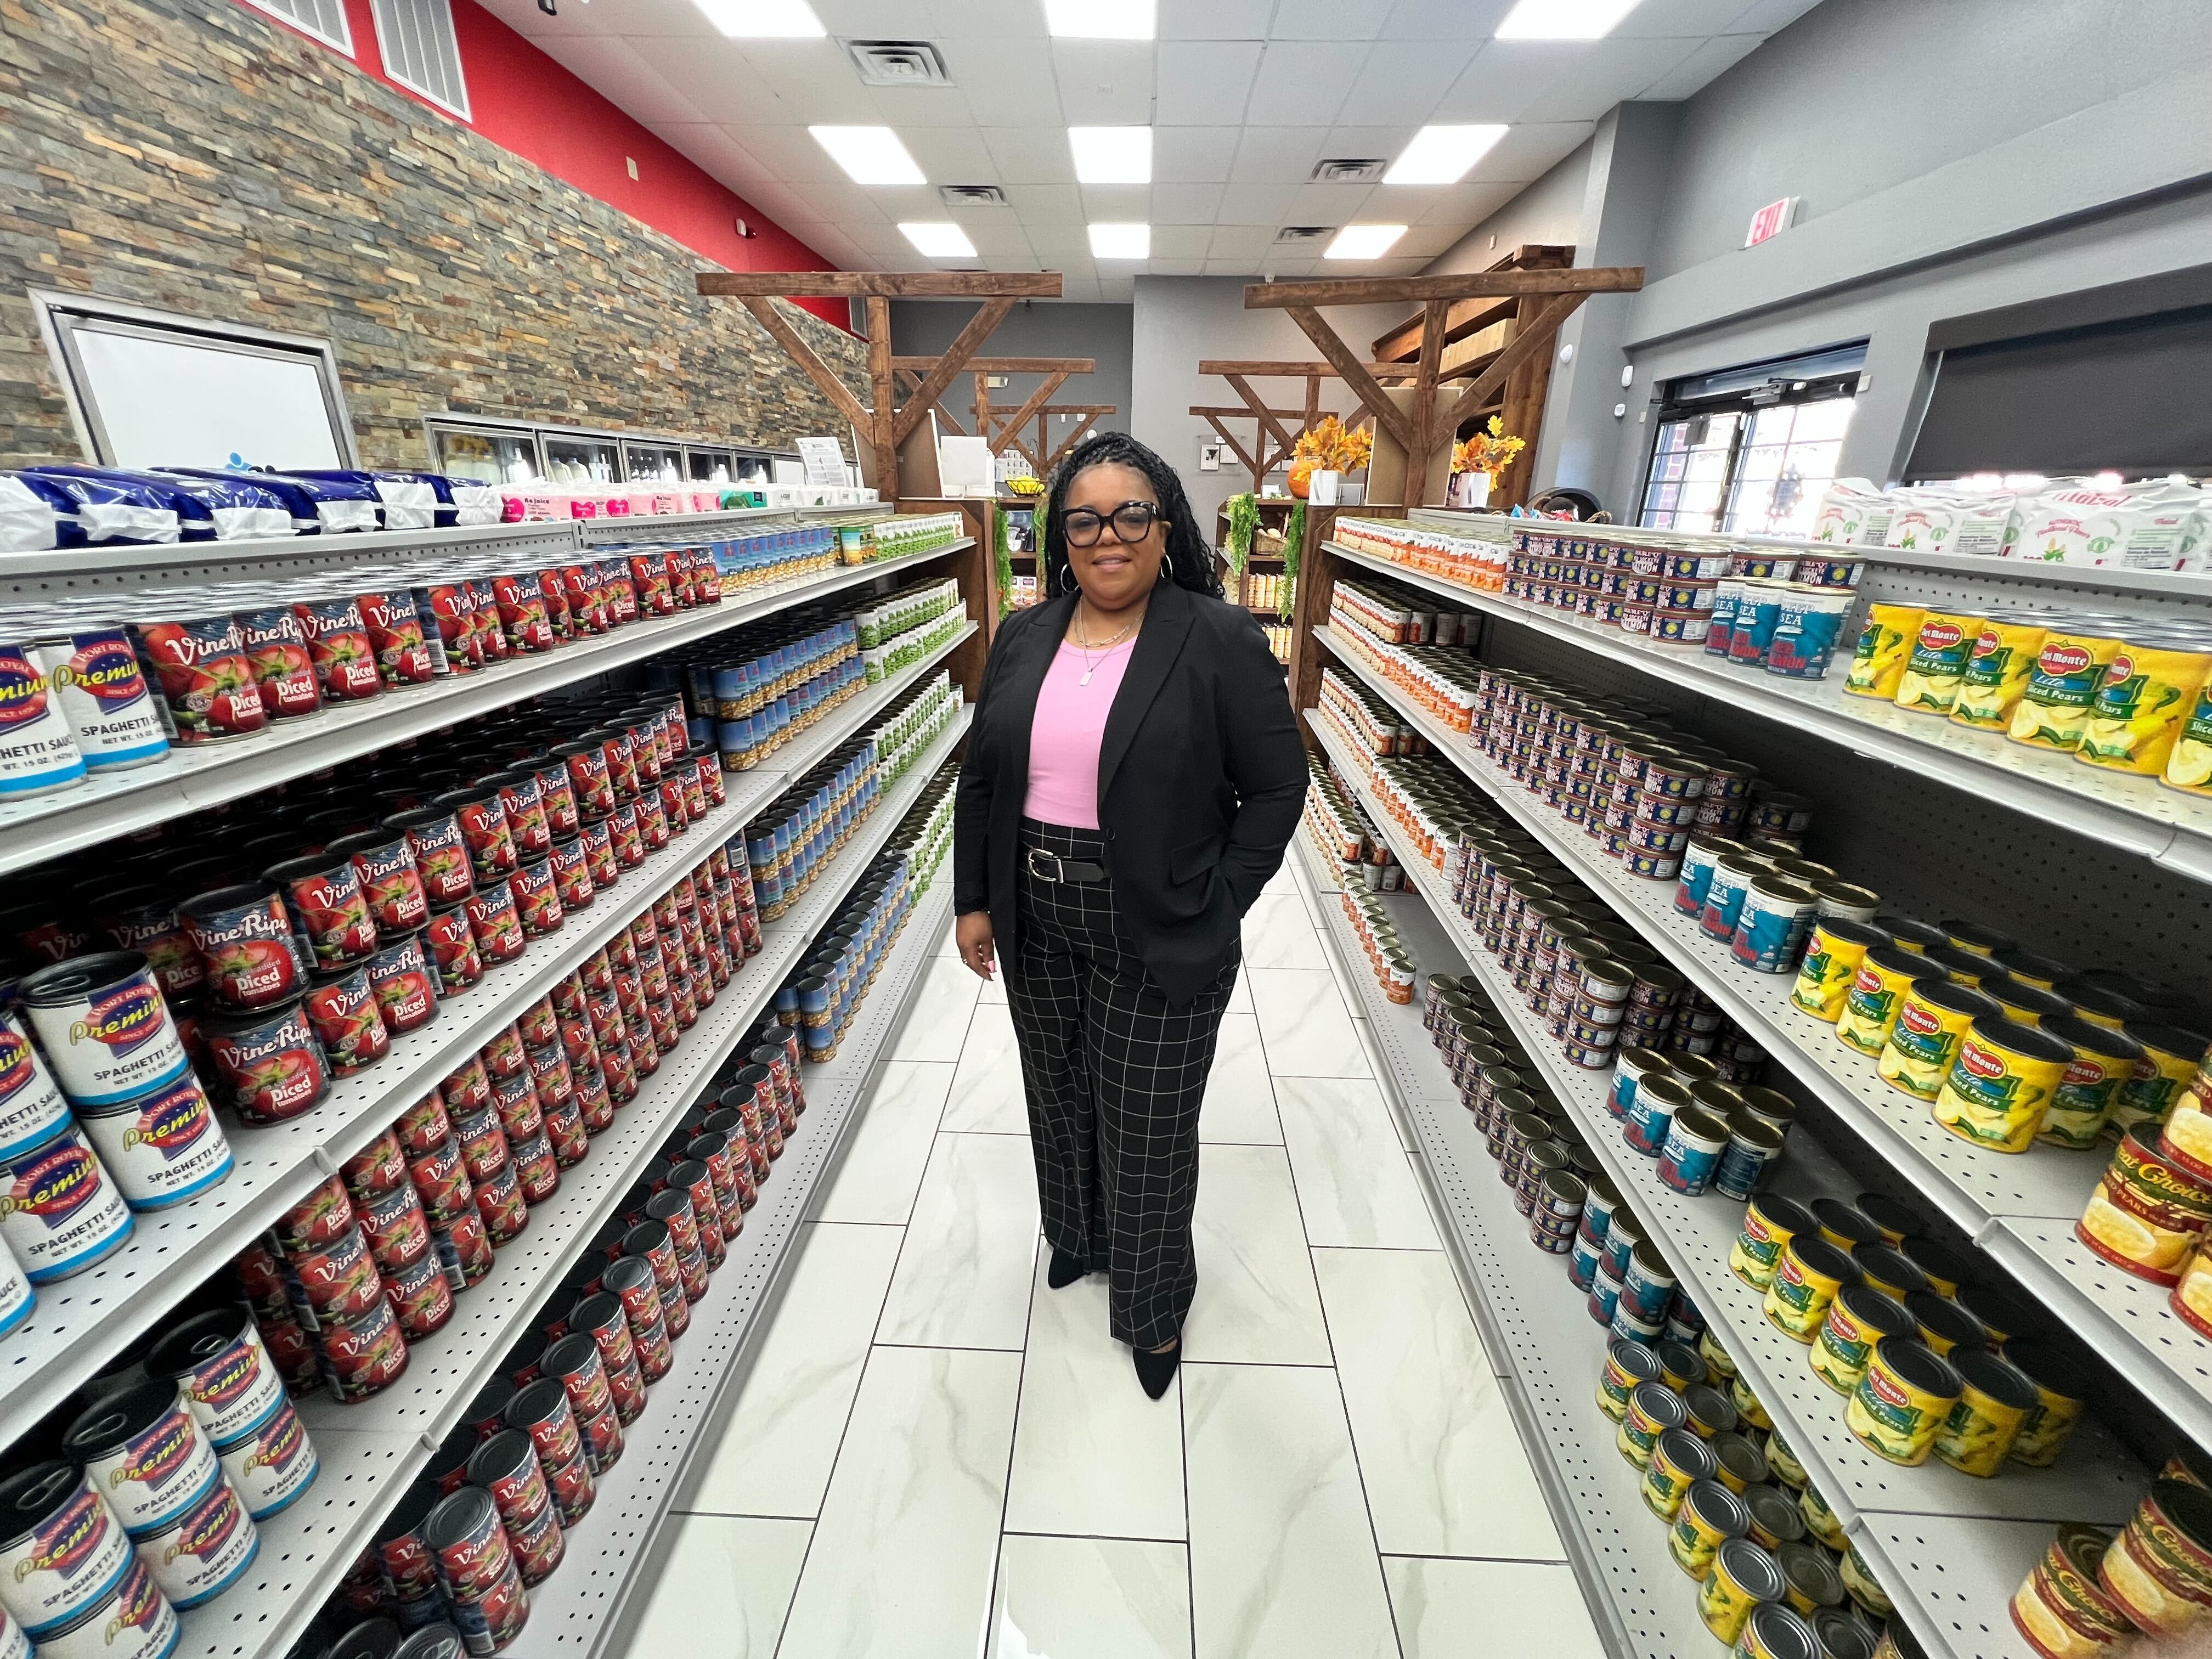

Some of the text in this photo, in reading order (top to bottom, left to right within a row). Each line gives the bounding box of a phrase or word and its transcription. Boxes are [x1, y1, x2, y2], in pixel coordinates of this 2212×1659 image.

[1930, 662, 1958, 673] Pears
[2052, 652, 2087, 667] Monte
[346, 661, 376, 680] Diced
[1970, 672, 1993, 682] Pears
[276, 676, 313, 697] Diced
[2051, 690, 2085, 703] Pears
[2100, 702, 2122, 715] Pears
[81, 716, 150, 737] SPAGHETTI
[0, 742, 46, 760] HETTI
[1742, 905, 1755, 921] EA
[236, 968, 281, 991] Diced
[242, 981, 281, 997] tomatoes
[393, 994, 426, 1019] Diced
[1856, 1002, 1878, 1018] Pears
[1911, 1013, 1938, 1030] Monte
[1909, 1045, 1936, 1060] Pears
[93, 1049, 165, 1081] SPAGHETTI
[1970, 1052, 2002, 1075] Monte
[269, 1075, 312, 1102] Diced
[1970, 1087, 1999, 1107] Pears
[0, 1103, 38, 1128] HETTI
[147, 1148, 212, 1183] SPAGHETTI
[2118, 1148, 2140, 1171] eat
[28, 1212, 105, 1255] SPAGHETTI
[1878, 1378, 1906, 1404] Monte
[1878, 1411, 1905, 1430] Pears
[133, 1469, 197, 1514] SPAGHETTI
[185, 1538, 242, 1587] SPAGHETTI
[43, 1549, 114, 1609] SPAGHETTI
